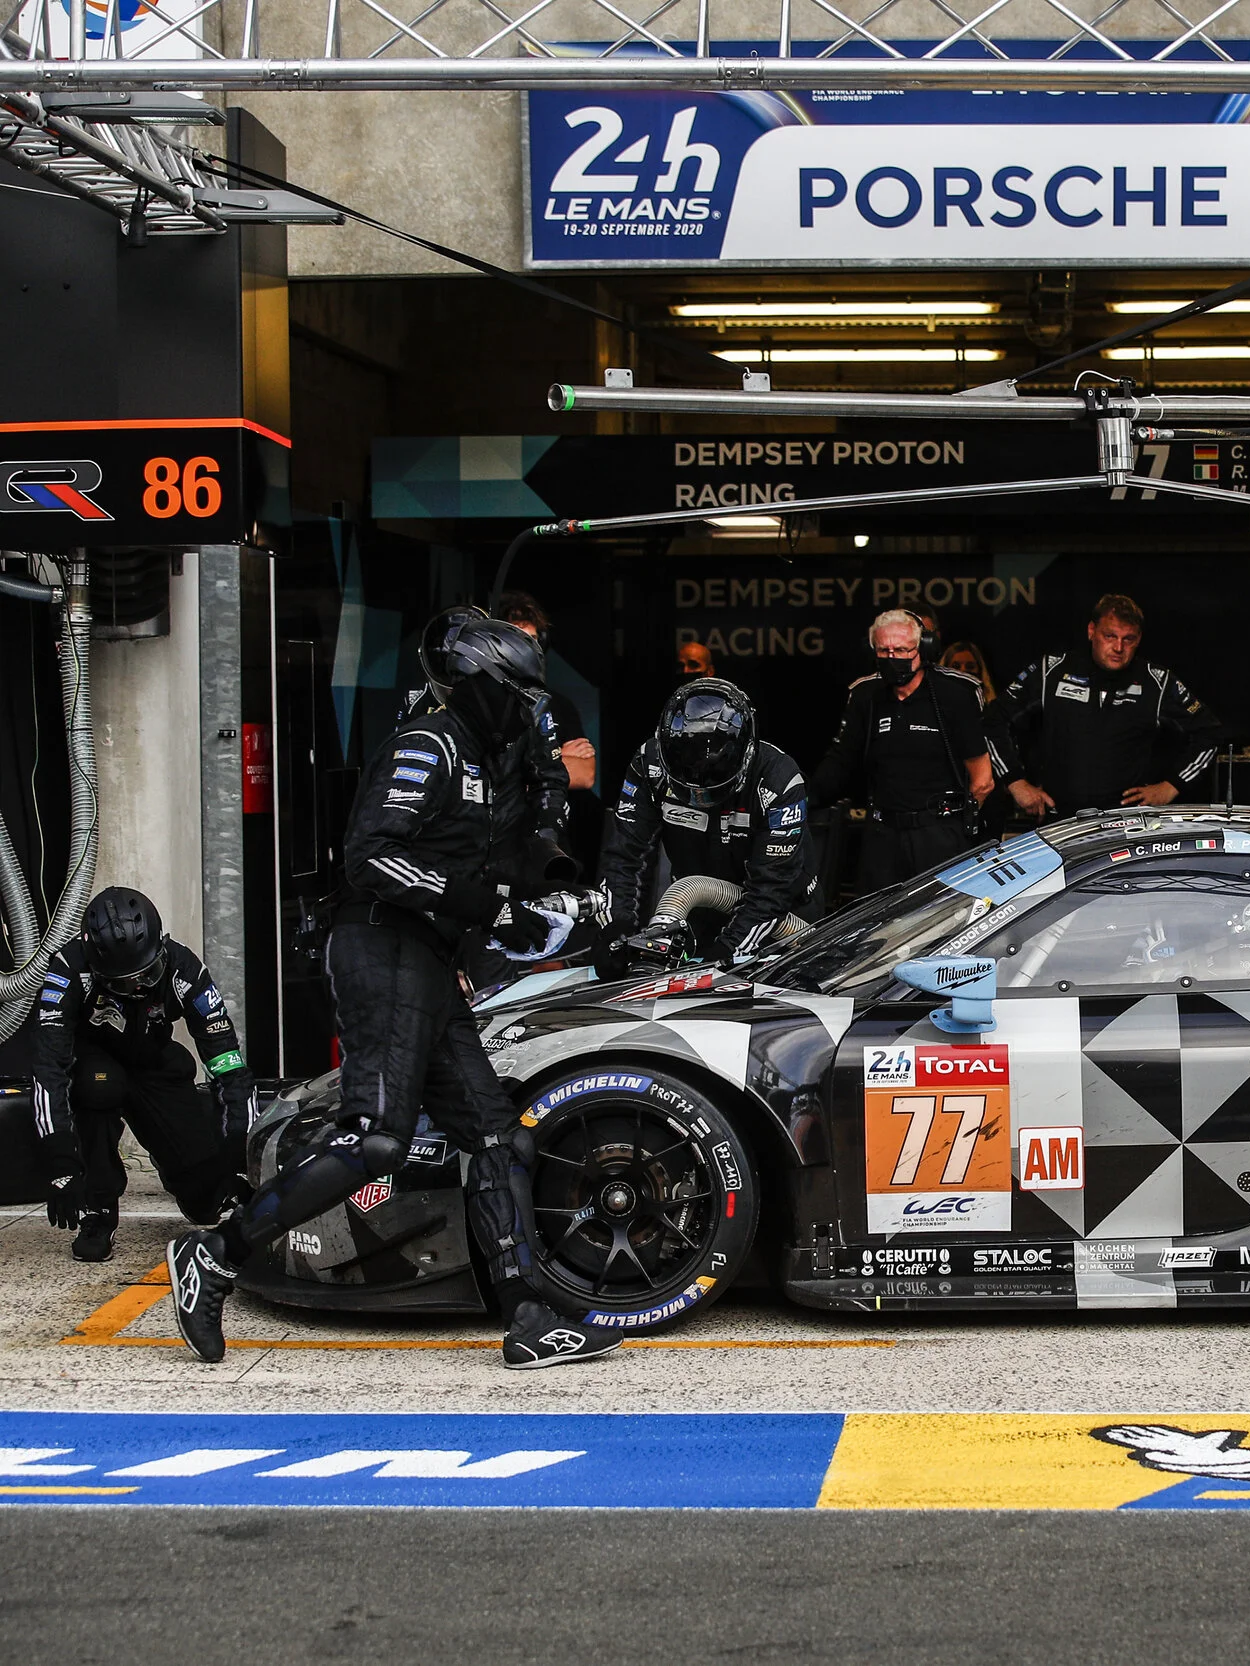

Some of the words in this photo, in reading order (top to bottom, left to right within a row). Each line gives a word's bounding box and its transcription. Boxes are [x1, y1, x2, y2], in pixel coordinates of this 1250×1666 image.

[551, 106, 721, 193] 24h
[799, 165, 1228, 229] PORSCHE
[544, 198, 594, 221] LE
[563, 223, 597, 236] 19-20
[600, 223, 670, 237] SEPTEMBRE
[673, 224, 703, 236] 2020
[675, 442, 825, 466] DEMPSEY
[833, 441, 964, 465] PROTON
[1231, 445, 1247, 459] C.
[1231, 465, 1248, 479] R.
[143, 456, 222, 518] 86
[675, 482, 796, 507] RACING
[675, 578, 861, 609] DEMPSEY
[873, 577, 1036, 606] PROTON
[676, 627, 825, 656] RACING
[1135, 846, 1149, 856] C.
[1152, 841, 1181, 852] Ried
[934, 962, 993, 985] Milwaukee
[868, 1051, 911, 1072] 24h
[919, 1056, 1004, 1074] TOTAL
[549, 1075, 643, 1106] MICHELIN
[889, 1095, 987, 1186] 77
[1024, 1137, 1079, 1181] AM
[902, 1197, 976, 1215] WEC
[288, 1229, 322, 1256] FARO
[1090, 1243, 1135, 1251] KÜCHEN
[711, 1252, 727, 1271] FL
[875, 1248, 937, 1263] CERUTTI
[974, 1249, 1052, 1265] STALOC
[1090, 1252, 1135, 1261] ZENTRUM
[1163, 1251, 1212, 1264] HAZET
[592, 1297, 687, 1327] MICHELIN
